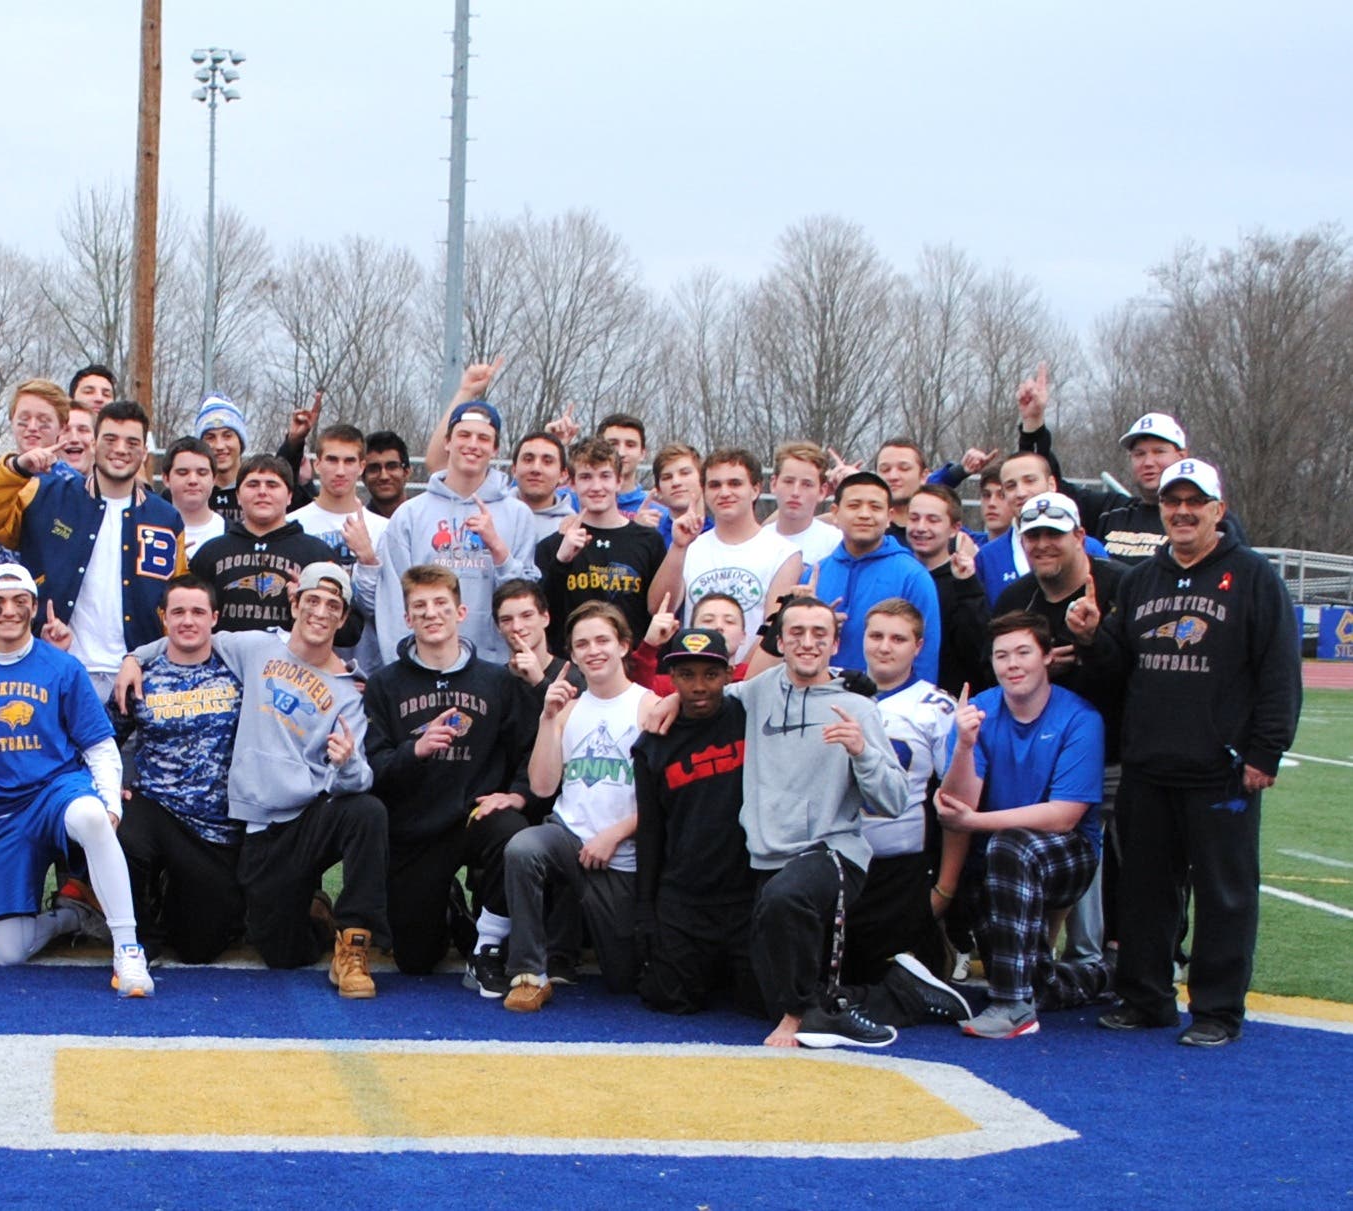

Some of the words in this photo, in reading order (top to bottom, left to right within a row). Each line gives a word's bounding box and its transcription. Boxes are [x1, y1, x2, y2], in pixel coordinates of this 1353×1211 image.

[1139, 417, 1153, 430] B
[1177, 461, 1196, 475] B
[136, 524, 177, 580] B
[567, 572, 642, 593] BOBCATS
[262, 659, 334, 714] BROOKFIELD
[147, 686, 237, 708] BROOKFIELD
[274, 692, 295, 711] 13
[153, 700, 232, 720] FOOTBALL
